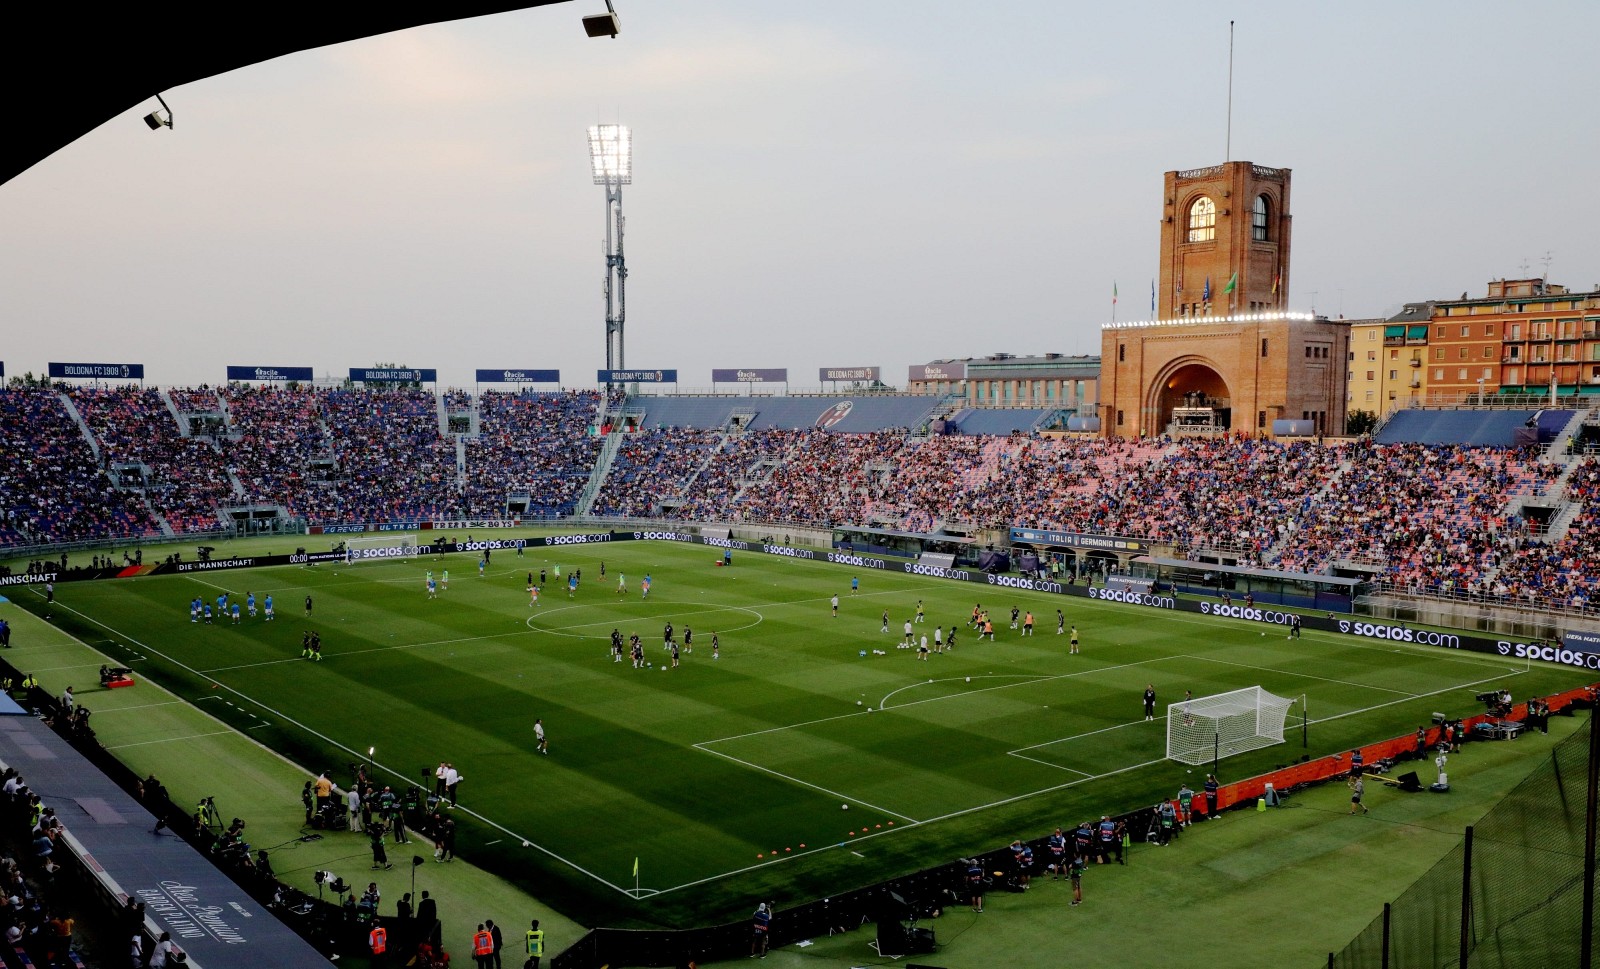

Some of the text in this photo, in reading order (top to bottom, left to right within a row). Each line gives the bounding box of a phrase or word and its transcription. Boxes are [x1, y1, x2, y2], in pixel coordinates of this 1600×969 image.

[65, 366, 119, 376] BOLOGNA FC 1909
[365, 371, 412, 380] BOLOGNA FC 1909
[612, 372, 654, 380] BOLOGNA FC 1909
[828, 369, 865, 379] BOLOGNA FC 1909
[380, 523, 418, 531] ULTRAS
[554, 533, 611, 544] SOCIOS.com
[643, 531, 693, 542] SOCIOS.com
[1049, 534, 1072, 544] ITALIA
[1080, 537, 1113, 548] GERMANIA
[709, 537, 748, 550] SOCIOS.com
[363, 543, 431, 558] SOCIOS.com
[769, 545, 814, 559] SOCIOS.com
[199, 559, 252, 570] MANNSCHAFT
[289, 554, 308, 563] 00:00
[834, 553, 885, 569] SOCIOS.com
[913, 563, 969, 581] SOCIOS.com
[997, 575, 1062, 594] SOCIOS.com
[1099, 588, 1175, 610] SOCIOS.com
[1353, 622, 1460, 649] SOCIOS.com
[1566, 633, 1582, 641] UEFA
[1515, 643, 1600, 671] SOCIOS.c
[136, 889, 205, 938] GARDEN PLATINO
[186, 904, 247, 945] Premium
